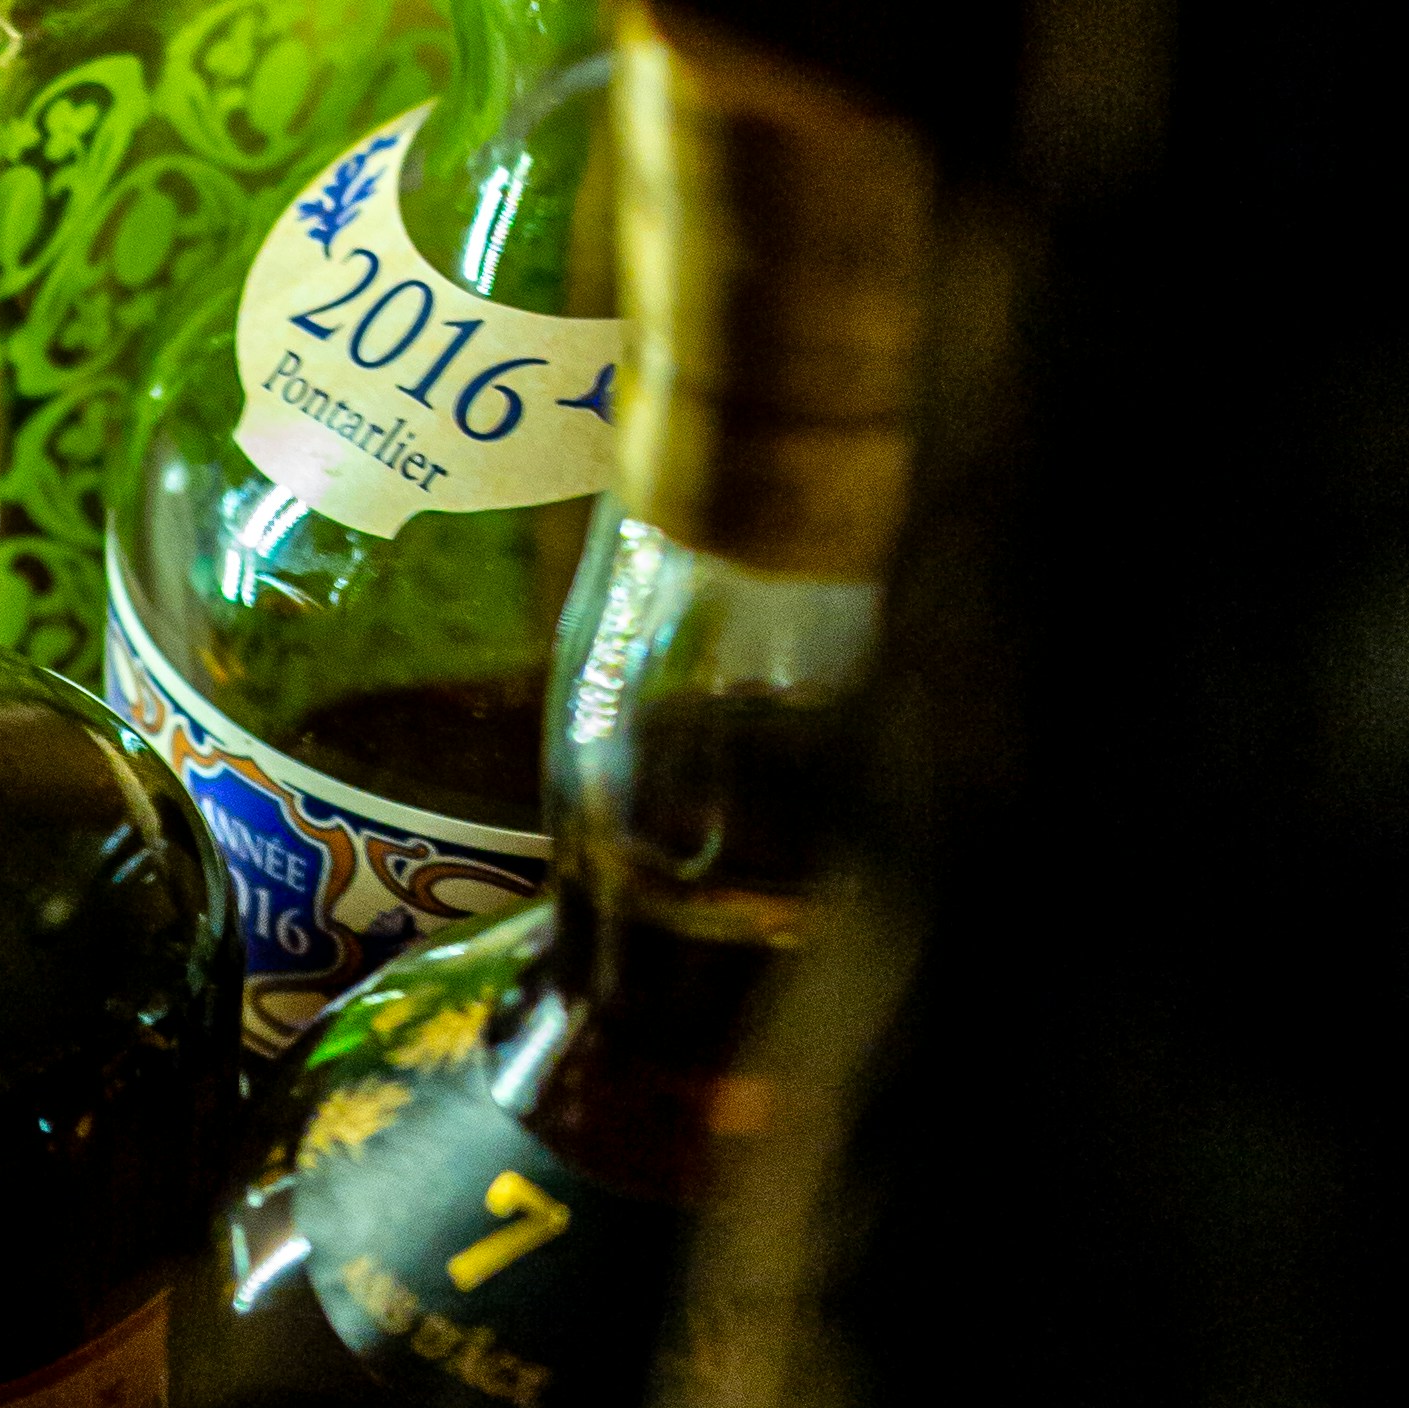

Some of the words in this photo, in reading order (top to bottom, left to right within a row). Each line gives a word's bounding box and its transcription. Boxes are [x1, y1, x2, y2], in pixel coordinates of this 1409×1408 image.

[290, 248, 549, 442] 2016
[261, 350, 450, 494] Pontarlier
[446, 1169, 572, 1294] 7
